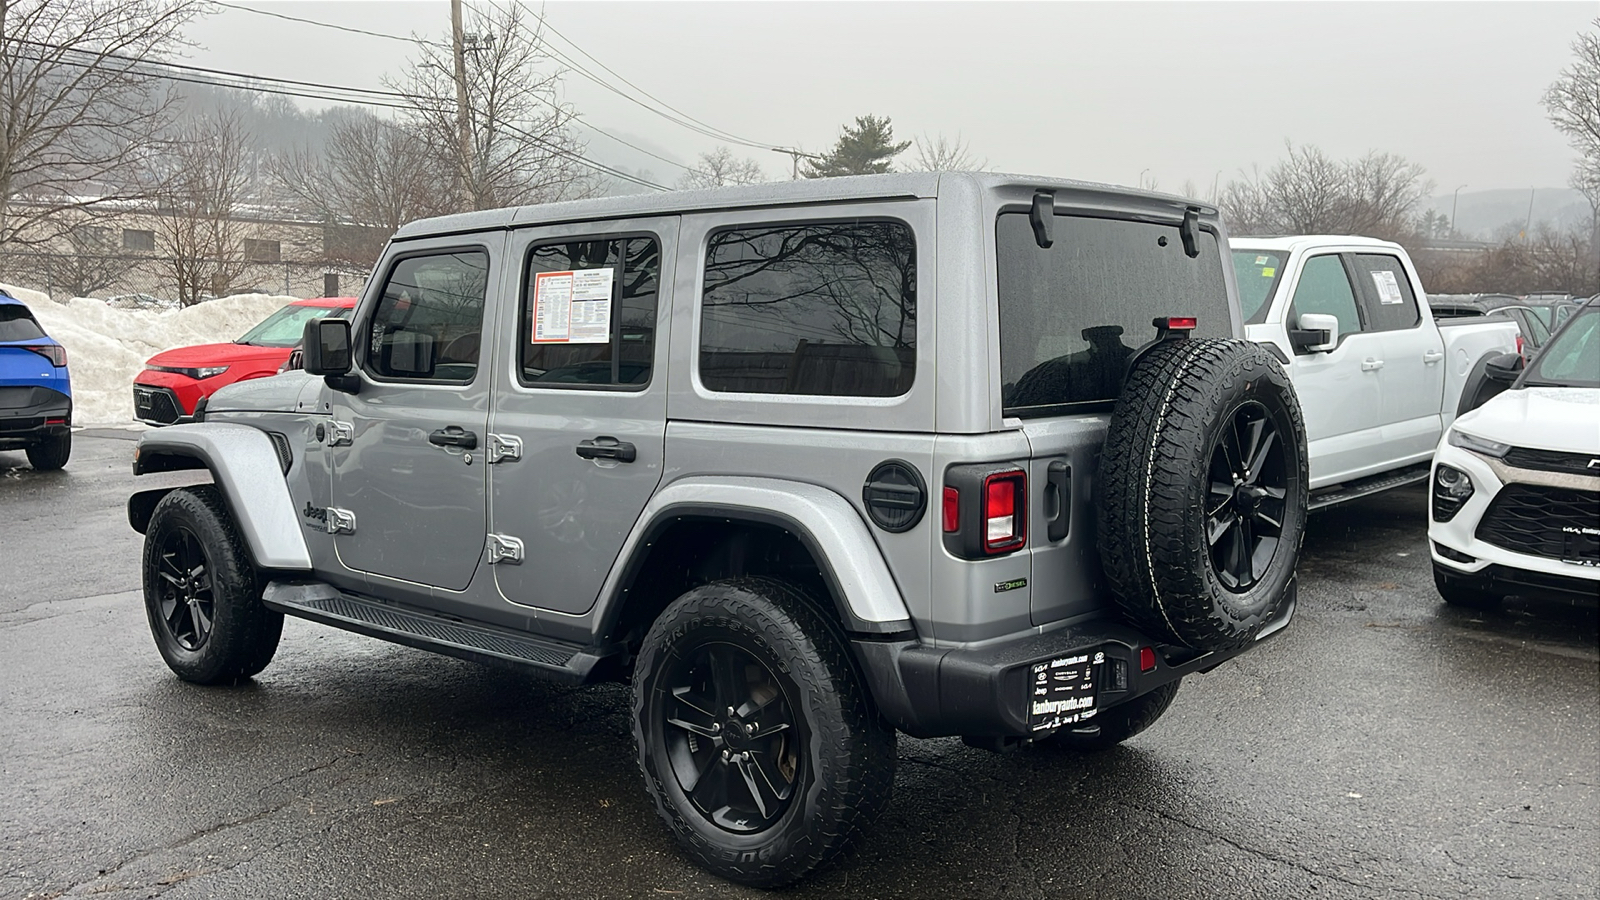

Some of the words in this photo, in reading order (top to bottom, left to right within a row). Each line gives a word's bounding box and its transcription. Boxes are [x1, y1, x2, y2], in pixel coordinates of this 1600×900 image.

[304, 502, 328, 524] Jeep
[660, 614, 792, 675] BRIDGESTONE
[1034, 687, 1048, 695] Jeep
